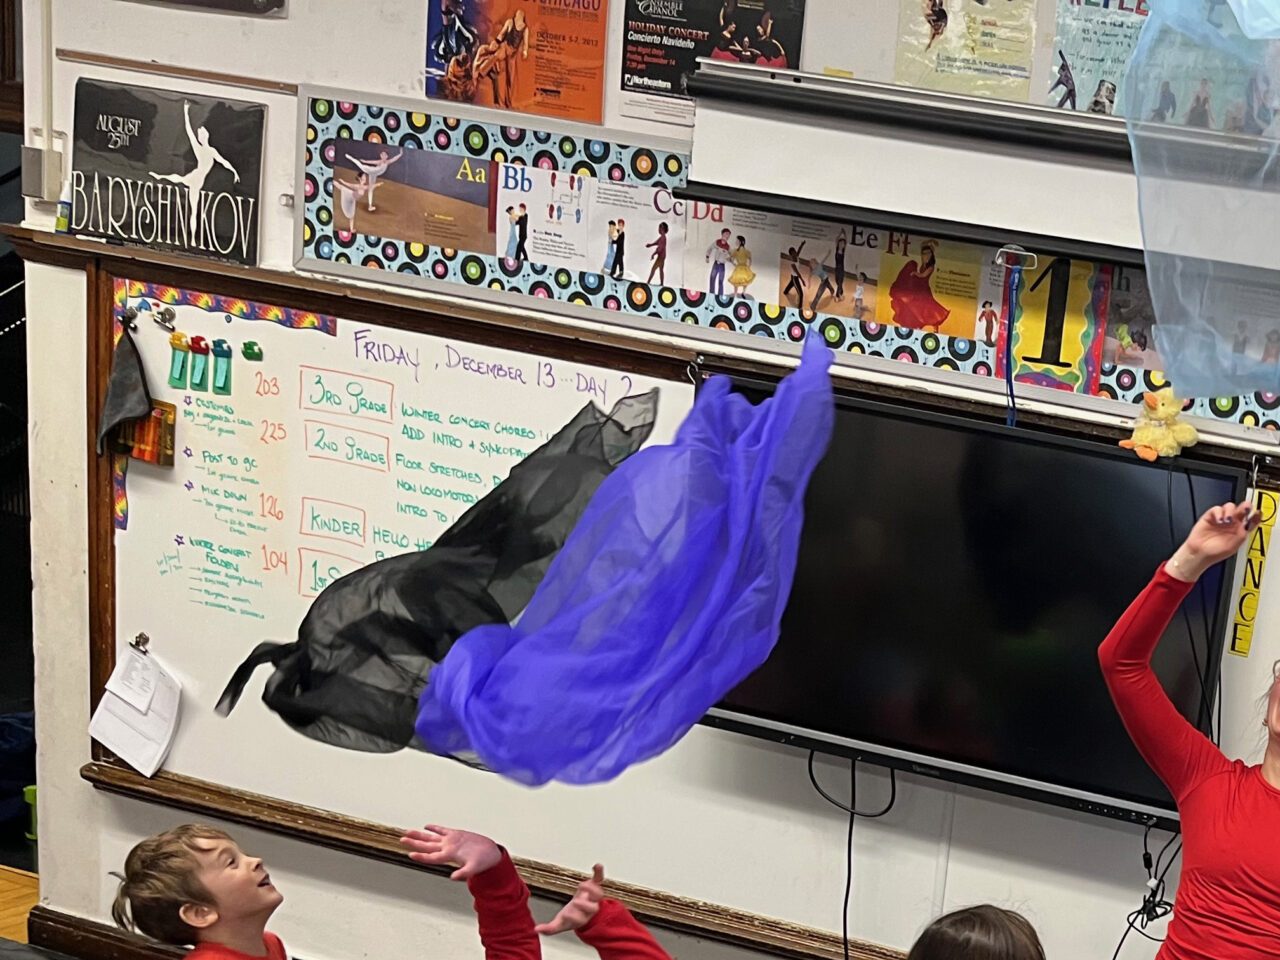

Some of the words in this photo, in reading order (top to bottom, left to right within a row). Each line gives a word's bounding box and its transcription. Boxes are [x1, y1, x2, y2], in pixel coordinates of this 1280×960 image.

[627, 30, 661, 44] Concierto
[661, 35, 695, 50] Navideño
[628, 20, 667, 34] HOLIDAY
[668, 26, 710, 41] CONCERT
[97, 114, 141, 137] AUGUST
[456, 157, 486, 184] Aa
[502, 165, 533, 193] Bb
[653, 188, 684, 217] Cc
[1022, 258, 1073, 368] 1
[445, 345, 527, 385] DECEMBER
[537, 361, 555, 388] 13
[255, 371, 280, 397] 203
[310, 375, 342, 405] 3RD
[401, 402, 442, 424] WINTER
[449, 414, 491, 431] CONCERT
[260, 419, 287, 444] 225
[314, 428, 339, 452] 2ND
[401, 424, 425, 441] ADD
[433, 433, 463, 449] INTRO
[395, 453, 424, 471] FLOOR
[396, 479, 417, 493] NON
[259, 492, 284, 520] 126
[396, 501, 427, 518] INTRO
[433, 510, 448, 523] TO
[311, 507, 363, 538] KINDER
[262, 544, 288, 575] 104
[1228, 491, 1277, 655] DANCE
